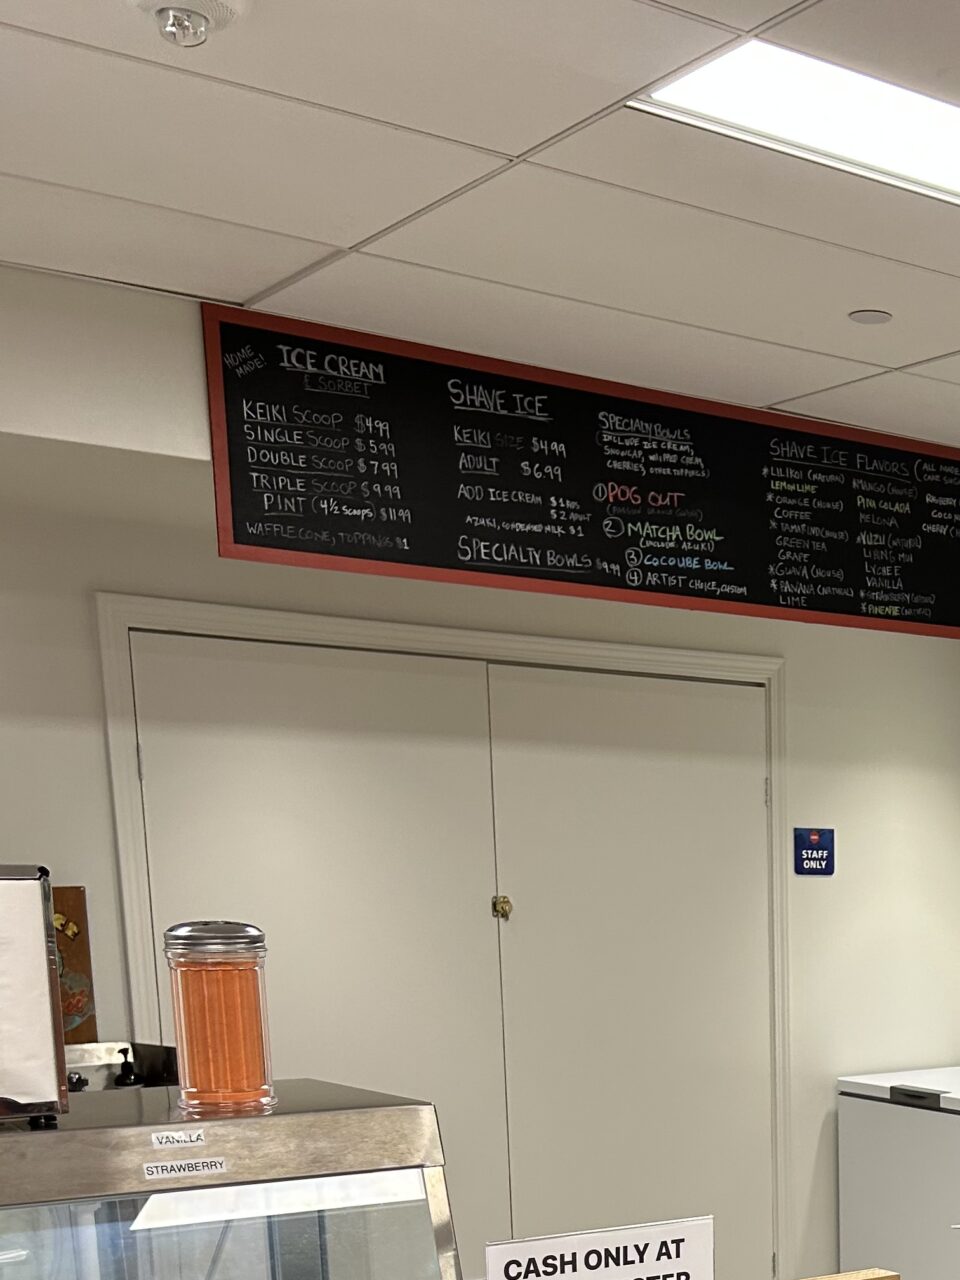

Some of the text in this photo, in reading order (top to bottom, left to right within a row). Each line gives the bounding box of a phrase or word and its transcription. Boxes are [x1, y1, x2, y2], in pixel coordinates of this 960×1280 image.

[223, 345, 256, 369] HOME
[276, 344, 386, 384] ICE CREAM
[318, 377, 372, 396] SORBET
[447, 379, 550, 418] SHAVE ICE
[243, 398, 287, 423] KEIKI
[293, 404, 344, 427] SCOOP
[244, 424, 351, 450] SINGLE SCOOP
[453, 424, 492, 446] KEIKI
[654, 423, 692, 442] BOWLS
[247, 446, 355, 473] DOUBLE SCOOP
[459, 452, 501, 473] ADULT
[769, 438, 911, 477] SHAVE ICE FLAVORS
[249, 472, 357, 496] TRIPLE SCOOP
[457, 483, 484, 501] ADD
[487, 487, 510, 502] ICE
[264, 493, 307, 513] PINT
[607, 481, 686, 507] POG OUT
[773, 508, 814, 521] COFFEE
[246, 522, 297, 538] WAFFLE
[626, 522, 725, 541] MATCHA BOWL
[457, 535, 593, 569] SPECIALTY BOWLS
[777, 549, 812, 564] GRAPE
[703, 559, 736, 571] BOWL
[645, 571, 689, 588] ARTIST
[865, 576, 904, 591] VANILLA
[779, 595, 809, 608] LIME
[801, 849, 828, 859] STAFF
[803, 860, 827, 869] ONLY
[146, 1159, 225, 1177] STRAWBERRY
[583, 1242, 650, 1271] ONLY
[655, 1237, 686, 1262] AT
